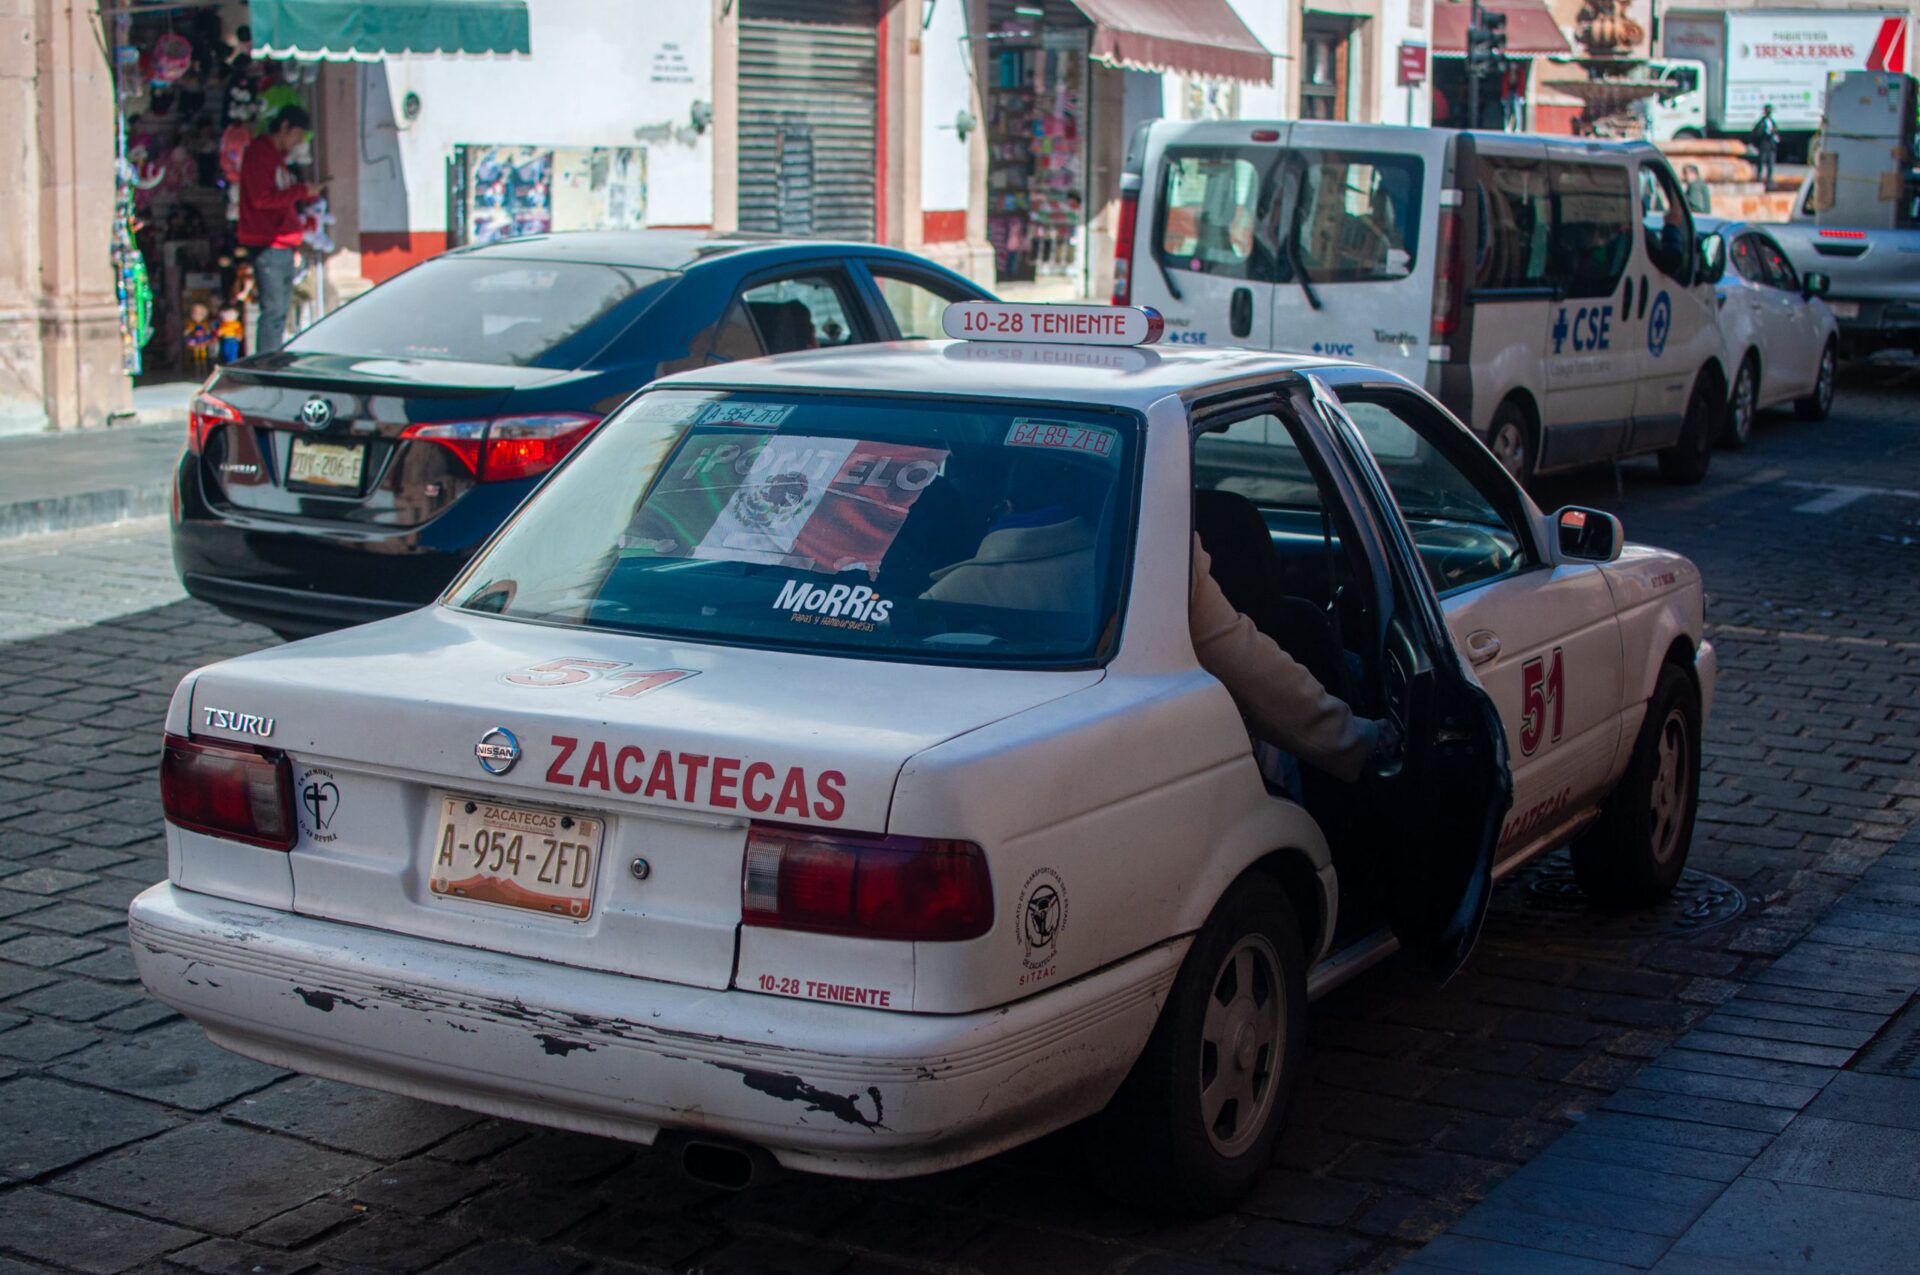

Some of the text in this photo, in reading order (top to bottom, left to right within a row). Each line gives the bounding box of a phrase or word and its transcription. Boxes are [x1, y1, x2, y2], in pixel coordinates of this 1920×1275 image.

[963, 311, 1126, 336] 10-28 TENIENTE
[1572, 306, 1613, 352] CSE
[1182, 331, 1207, 345] CSE
[1325, 343, 1354, 356] UVC
[498, 656, 703, 698] 51
[1519, 646, 1565, 757] 51
[204, 706, 275, 737] TSURU
[478, 746, 515, 758] NISSAN
[304, 767, 334, 780] MEMORIA
[546, 735, 847, 821] ZACATECAS
[448, 801, 456, 816] T
[484, 807, 557, 829] ZACATECAS
[1501, 786, 1570, 848] ACATECAS
[438, 823, 590, 889] A-954-ZFD
[1018, 965, 1056, 986] SITZAC
[758, 974, 891, 1006] 10-28 TENIENTE
